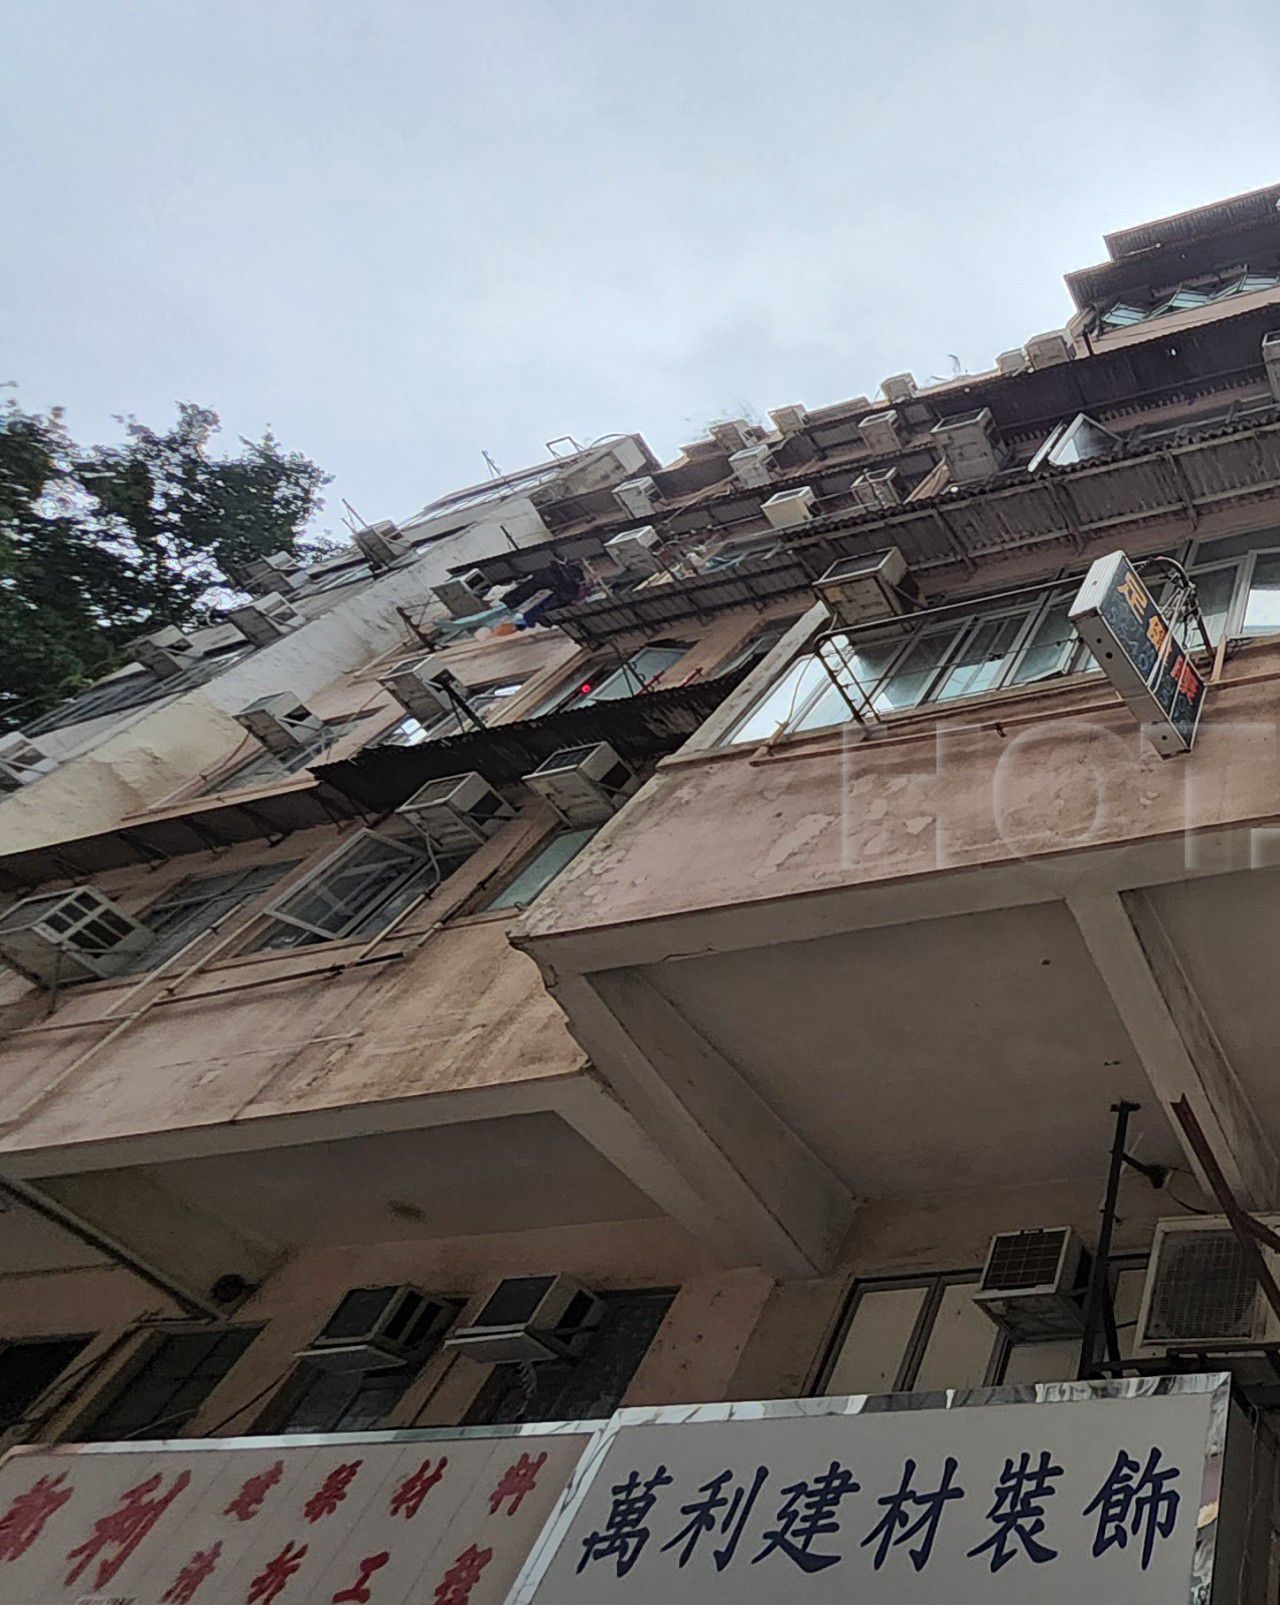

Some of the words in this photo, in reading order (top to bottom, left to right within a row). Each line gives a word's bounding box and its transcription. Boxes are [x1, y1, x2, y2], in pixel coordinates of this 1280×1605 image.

[577, 1446, 1181, 1578] 萬利建材裝飾
